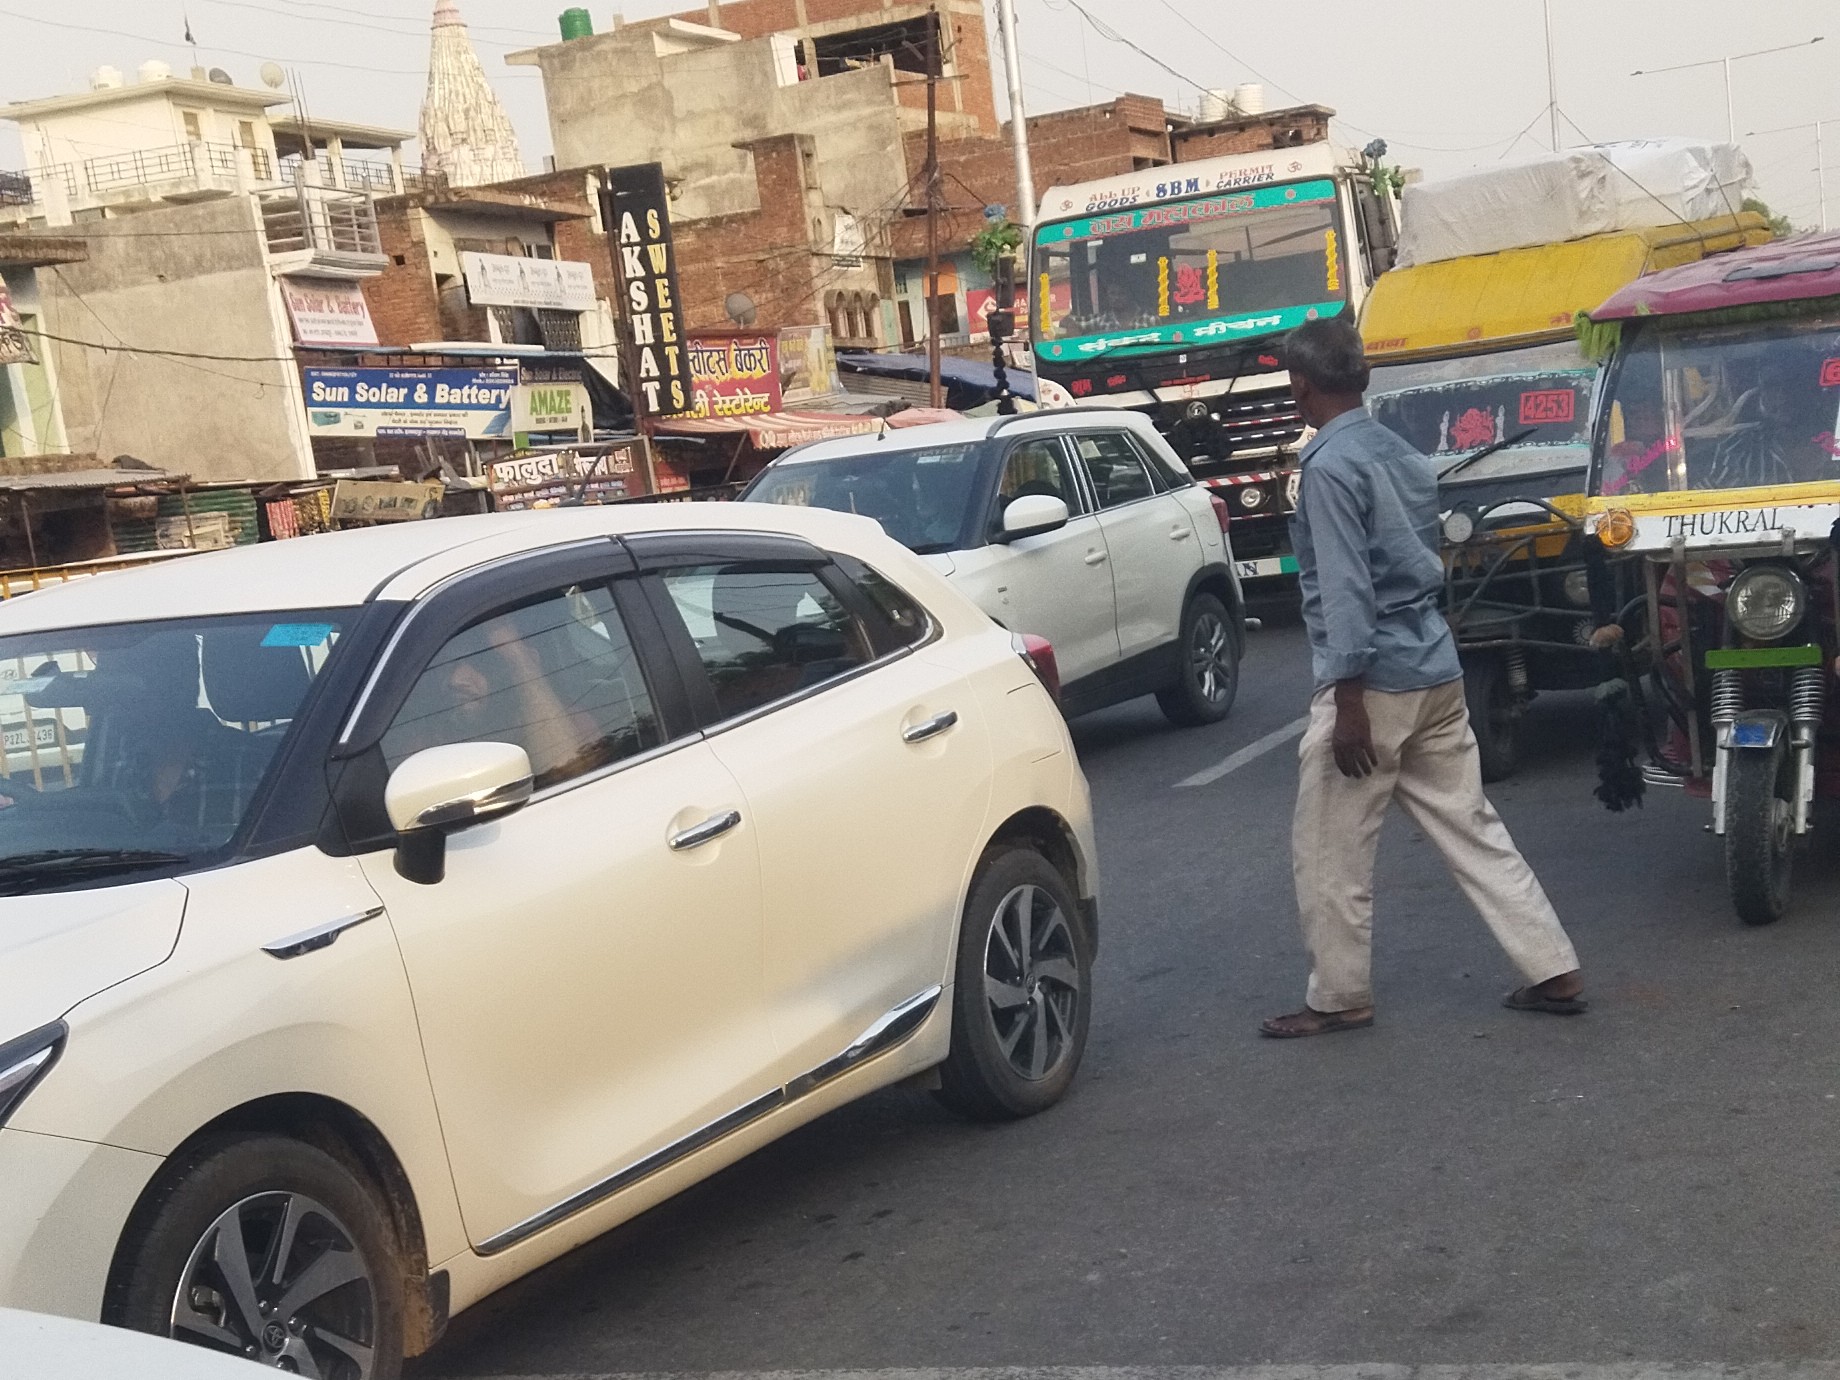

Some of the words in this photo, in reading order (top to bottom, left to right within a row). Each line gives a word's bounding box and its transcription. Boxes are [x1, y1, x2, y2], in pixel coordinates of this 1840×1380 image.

[1216, 172, 1275, 190] CARRIER
[1219, 163, 1274, 180] PERMIT
[1122, 185, 1140, 197] UP
[1156, 177, 1200, 199] SBM
[1085, 194, 1140, 212] GOODS
[289, 292, 306, 312] Sun
[304, 292, 325, 314] Solar
[326, 294, 335, 314] &
[335, 294, 366, 319] Battery
[620, 211, 660, 413] AKSHAT
[647, 208, 685, 409] SWEETS
[731, 336, 771, 374] बेकरी
[312, 381, 350, 402] Sun
[355, 382, 408, 403] Solar
[413, 383, 428, 404] &
[434, 384, 511, 409] Battery
[530, 389, 572, 416] AMAZE
[493, 453, 559, 485] फालुदा
[1664, 508, 1784, 538] THUKRAL
